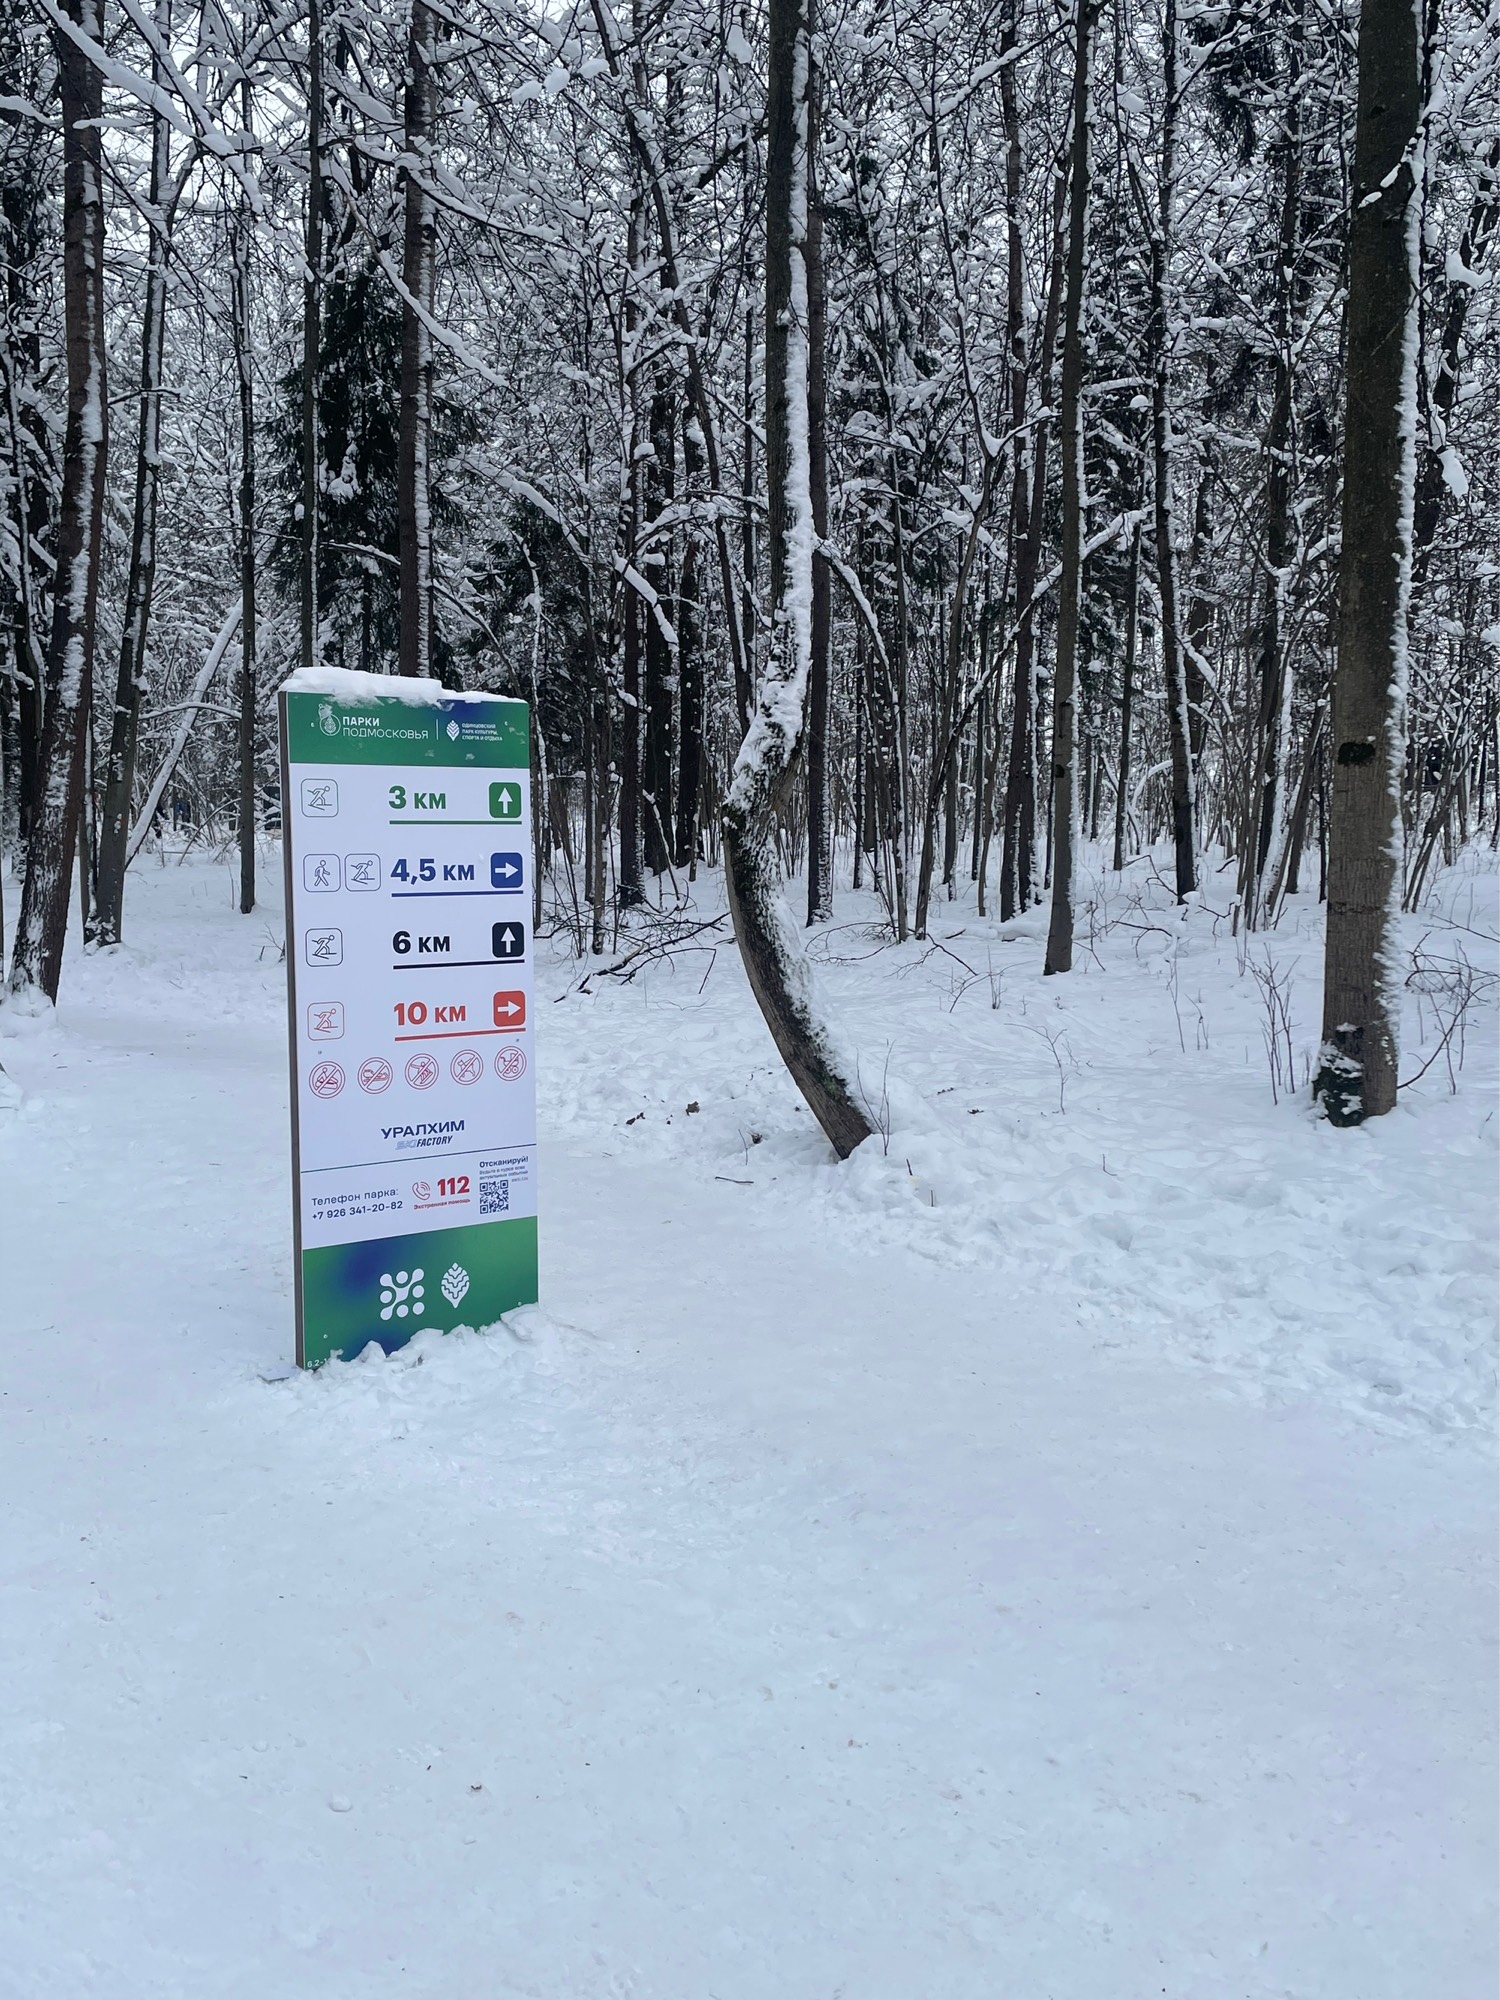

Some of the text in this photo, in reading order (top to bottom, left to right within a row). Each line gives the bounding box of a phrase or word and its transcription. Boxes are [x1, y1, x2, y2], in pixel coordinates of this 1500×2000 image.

[342, 716, 380, 727] ПАРКИ
[342, 727, 429, 740] ПОДМОСКОВЬЯ
[388, 785, 407, 810] 3
[390, 858, 437, 885] 4,5
[392, 930, 412, 955] 6
[393, 1001, 428, 1026] 10
[380, 1119, 465, 1139] УРАЛХИМ
[479, 1155, 529, 1168] Отсканируй!
[437, 1175, 470, 1197] 112
[311, 1188, 399, 1206] Телефон парка:
[312, 1200, 403, 1220] +7 926 341-20-82
